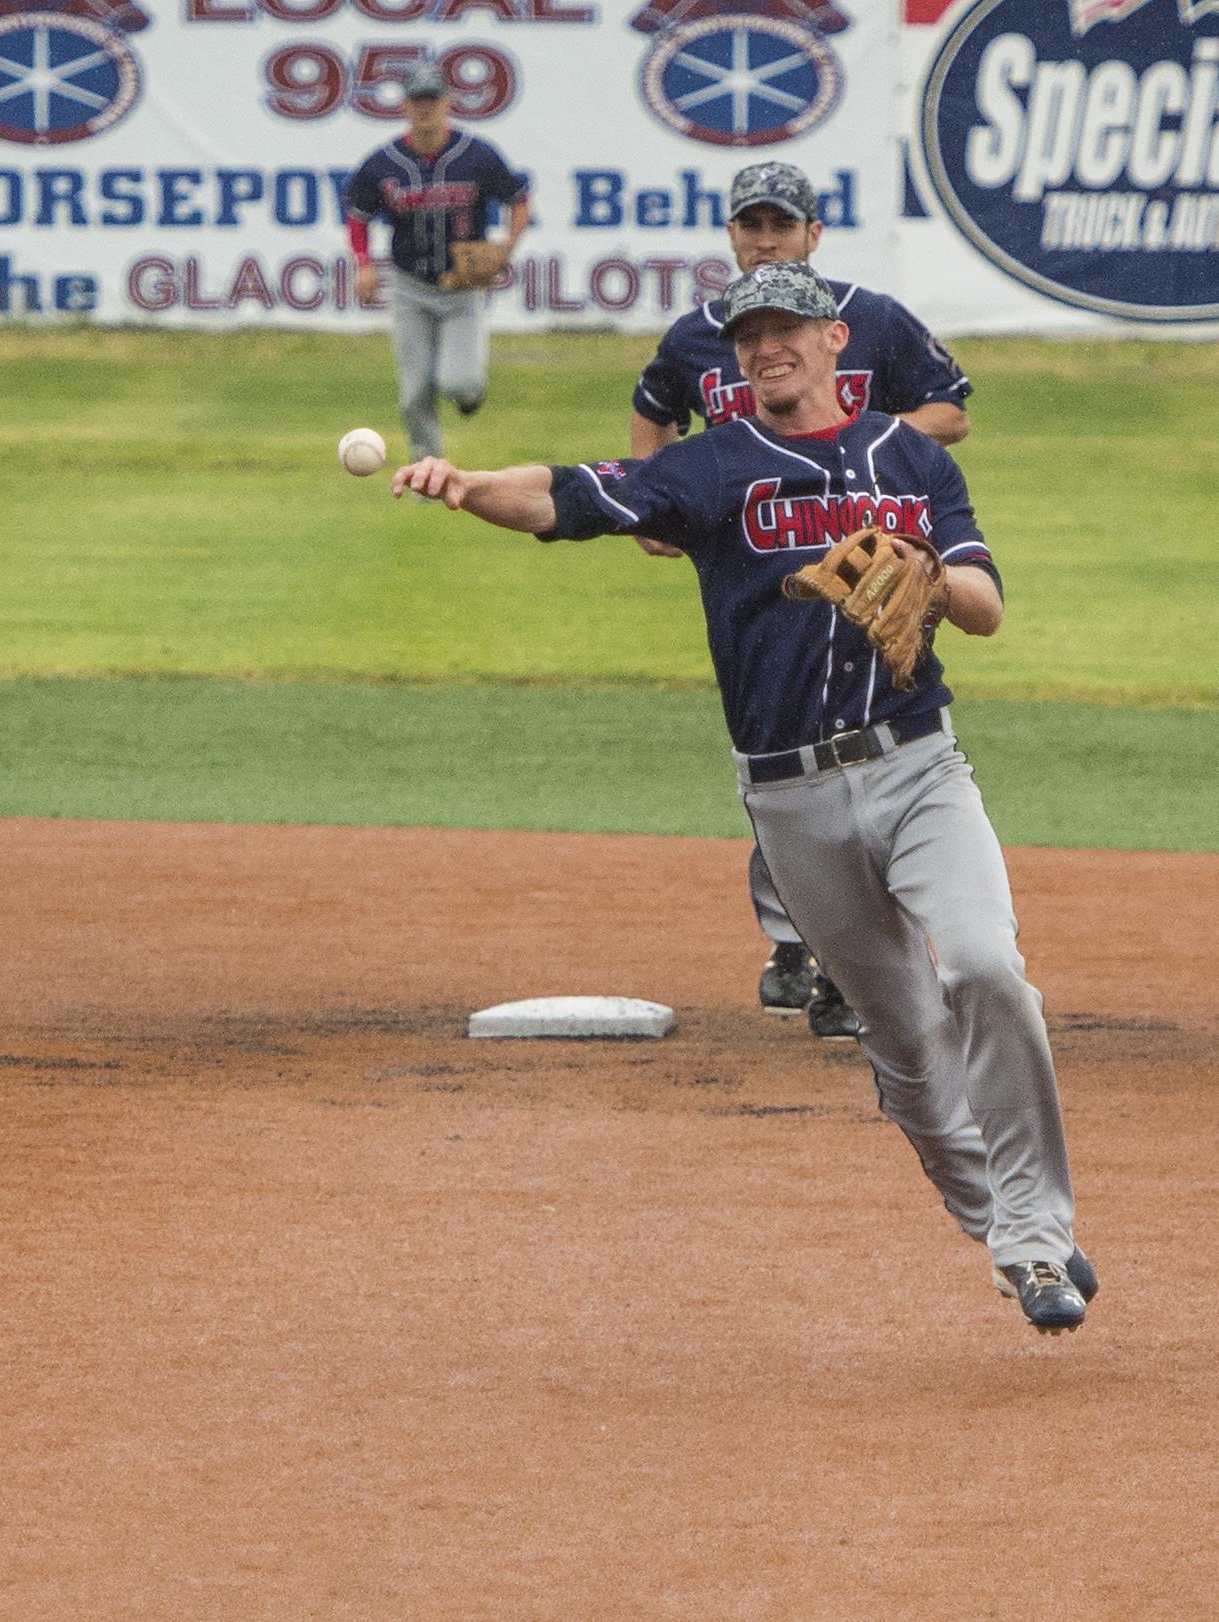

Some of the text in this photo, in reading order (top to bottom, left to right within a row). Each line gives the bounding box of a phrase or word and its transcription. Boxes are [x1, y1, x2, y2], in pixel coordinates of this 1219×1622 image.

[263, 41, 521, 122] 959
[966, 31, 1219, 203] Speci
[573, 168, 858, 228] Behd
[1041, 191, 1148, 250] TRUCK
[127, 255, 396, 311] GLACIE
[742, 476, 934, 554] CHINOOK
[866, 563, 894, 602] A2000
